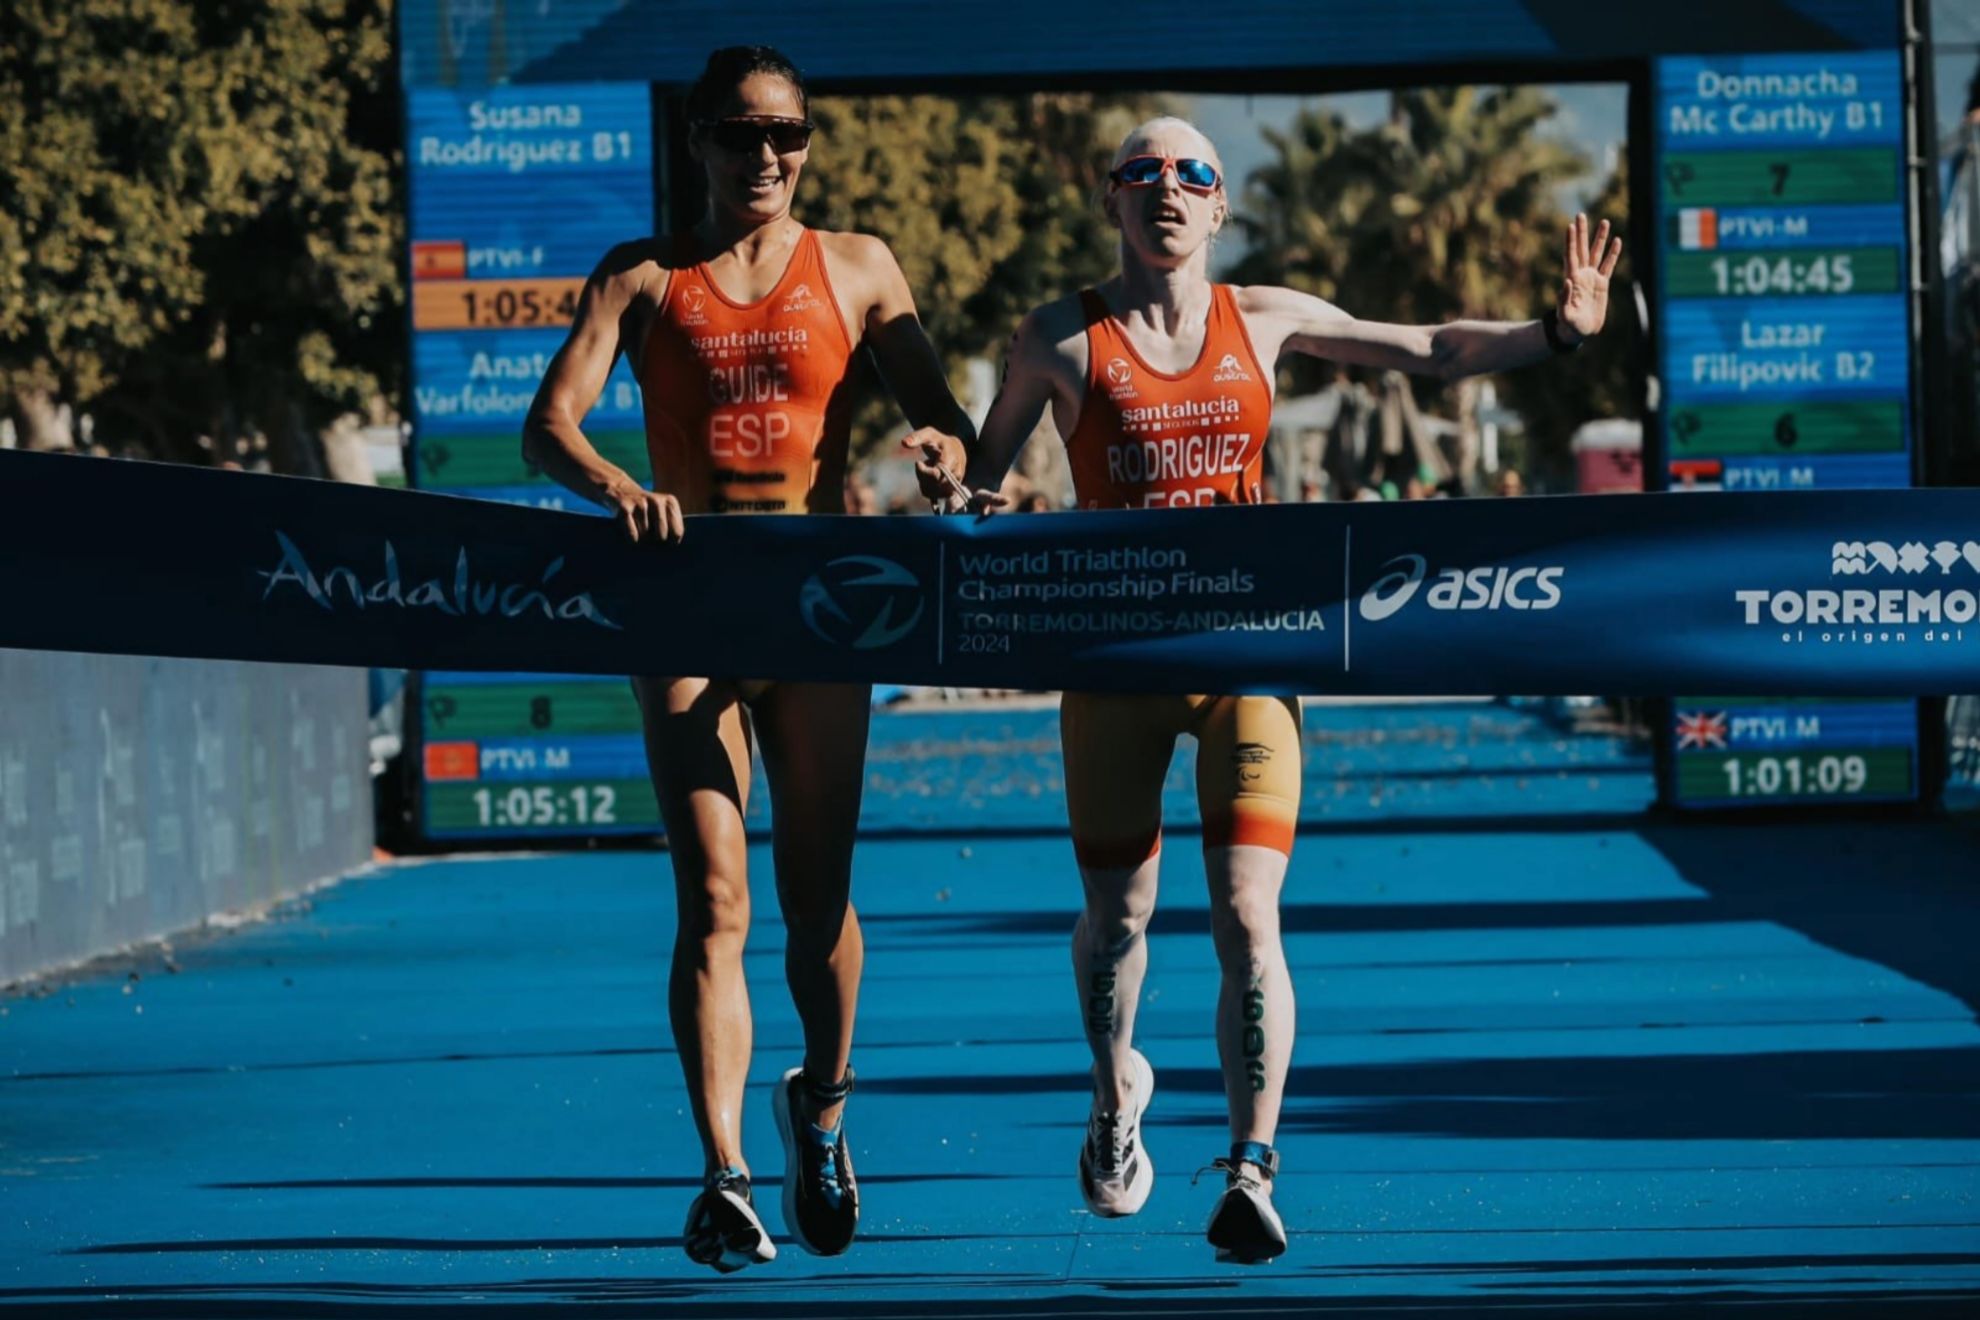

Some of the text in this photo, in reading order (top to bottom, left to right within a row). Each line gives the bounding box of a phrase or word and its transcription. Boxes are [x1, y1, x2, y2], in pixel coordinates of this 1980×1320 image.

[1697, 69, 1858, 98] Donnacha
[469, 101, 582, 130] Susana
[1670, 101, 1882, 139] Mc Carthy B1
[420, 131, 631, 174] Rodriguez B1
[1769, 163, 1790, 196] 7
[1711, 256, 1854, 294] 1:04:45
[462, 287, 576, 324] 1:05:4
[1741, 321, 1825, 348] Lazar
[709, 364, 789, 404] GUIDE
[1692, 352, 1875, 391] Filipovic B2
[710, 411, 791, 457] ESP
[1773, 413, 1797, 447] 6
[1107, 433, 1251, 483] RODRIGUEZ
[256, 529, 625, 630] Andalucía
[958, 546, 1187, 577] World Triathlon
[957, 568, 1256, 603] Championship Finals
[1735, 589, 1980, 624] TORREMO
[958, 633, 1011, 654] 2024
[1781, 630, 1962, 644] el origen del
[530, 695, 552, 730] 8
[1723, 756, 1867, 795] 1:01:09
[474, 786, 616, 826] 1:05:12
